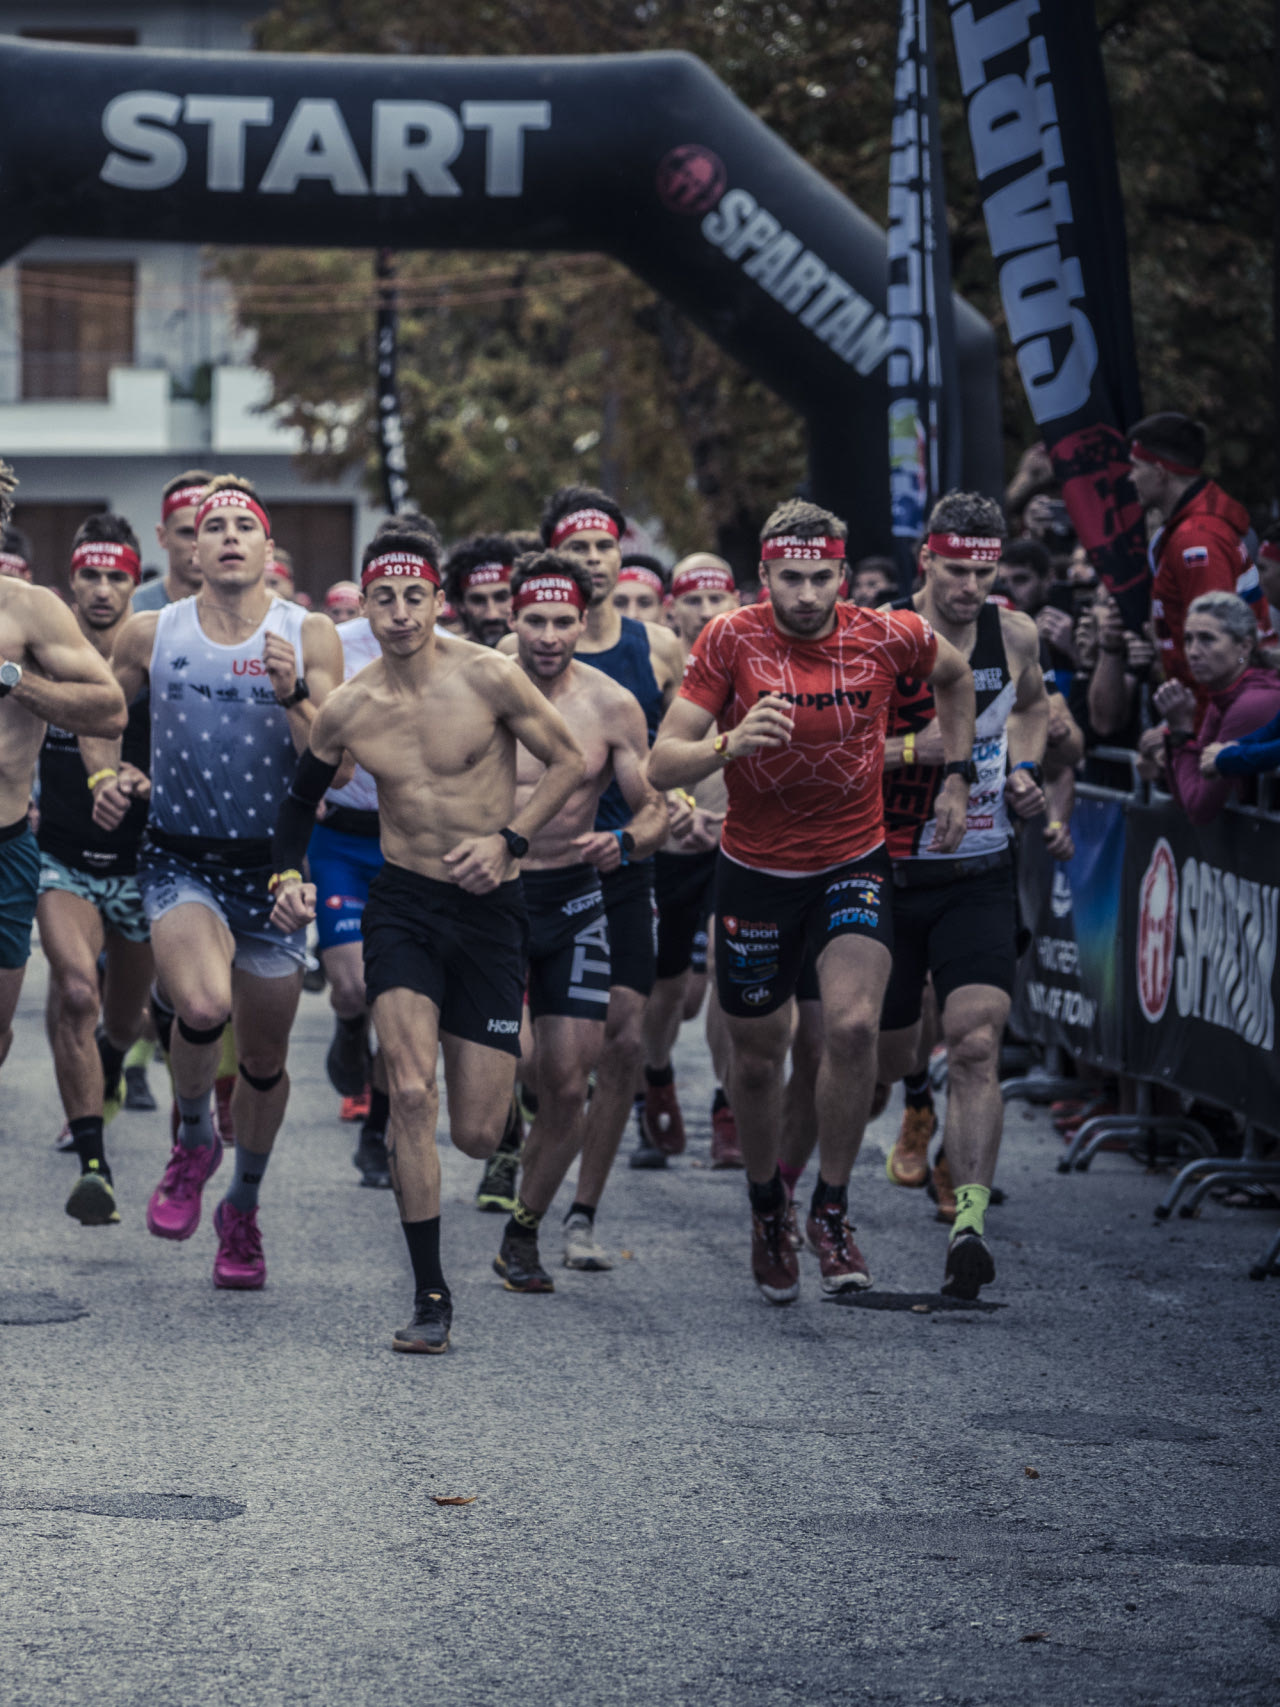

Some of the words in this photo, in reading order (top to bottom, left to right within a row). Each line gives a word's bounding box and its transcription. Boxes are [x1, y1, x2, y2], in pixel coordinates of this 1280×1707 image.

[99, 90, 552, 197] START
[950, 0, 1098, 425] SPART
[702, 188, 892, 377] SPARTAN
[377, 553, 425, 567] SPARTAN
[783, 547, 822, 559] 2223
[384, 564, 421, 577] 3013
[529, 577, 573, 590] SPARTAN
[535, 589, 569, 601] 2651
[233, 659, 269, 676] US
[826, 879, 881, 895] ATEX
[828, 912, 879, 932] RUN
[740, 929, 780, 939] sport
[1177, 856, 1280, 1050] SPARTAN
